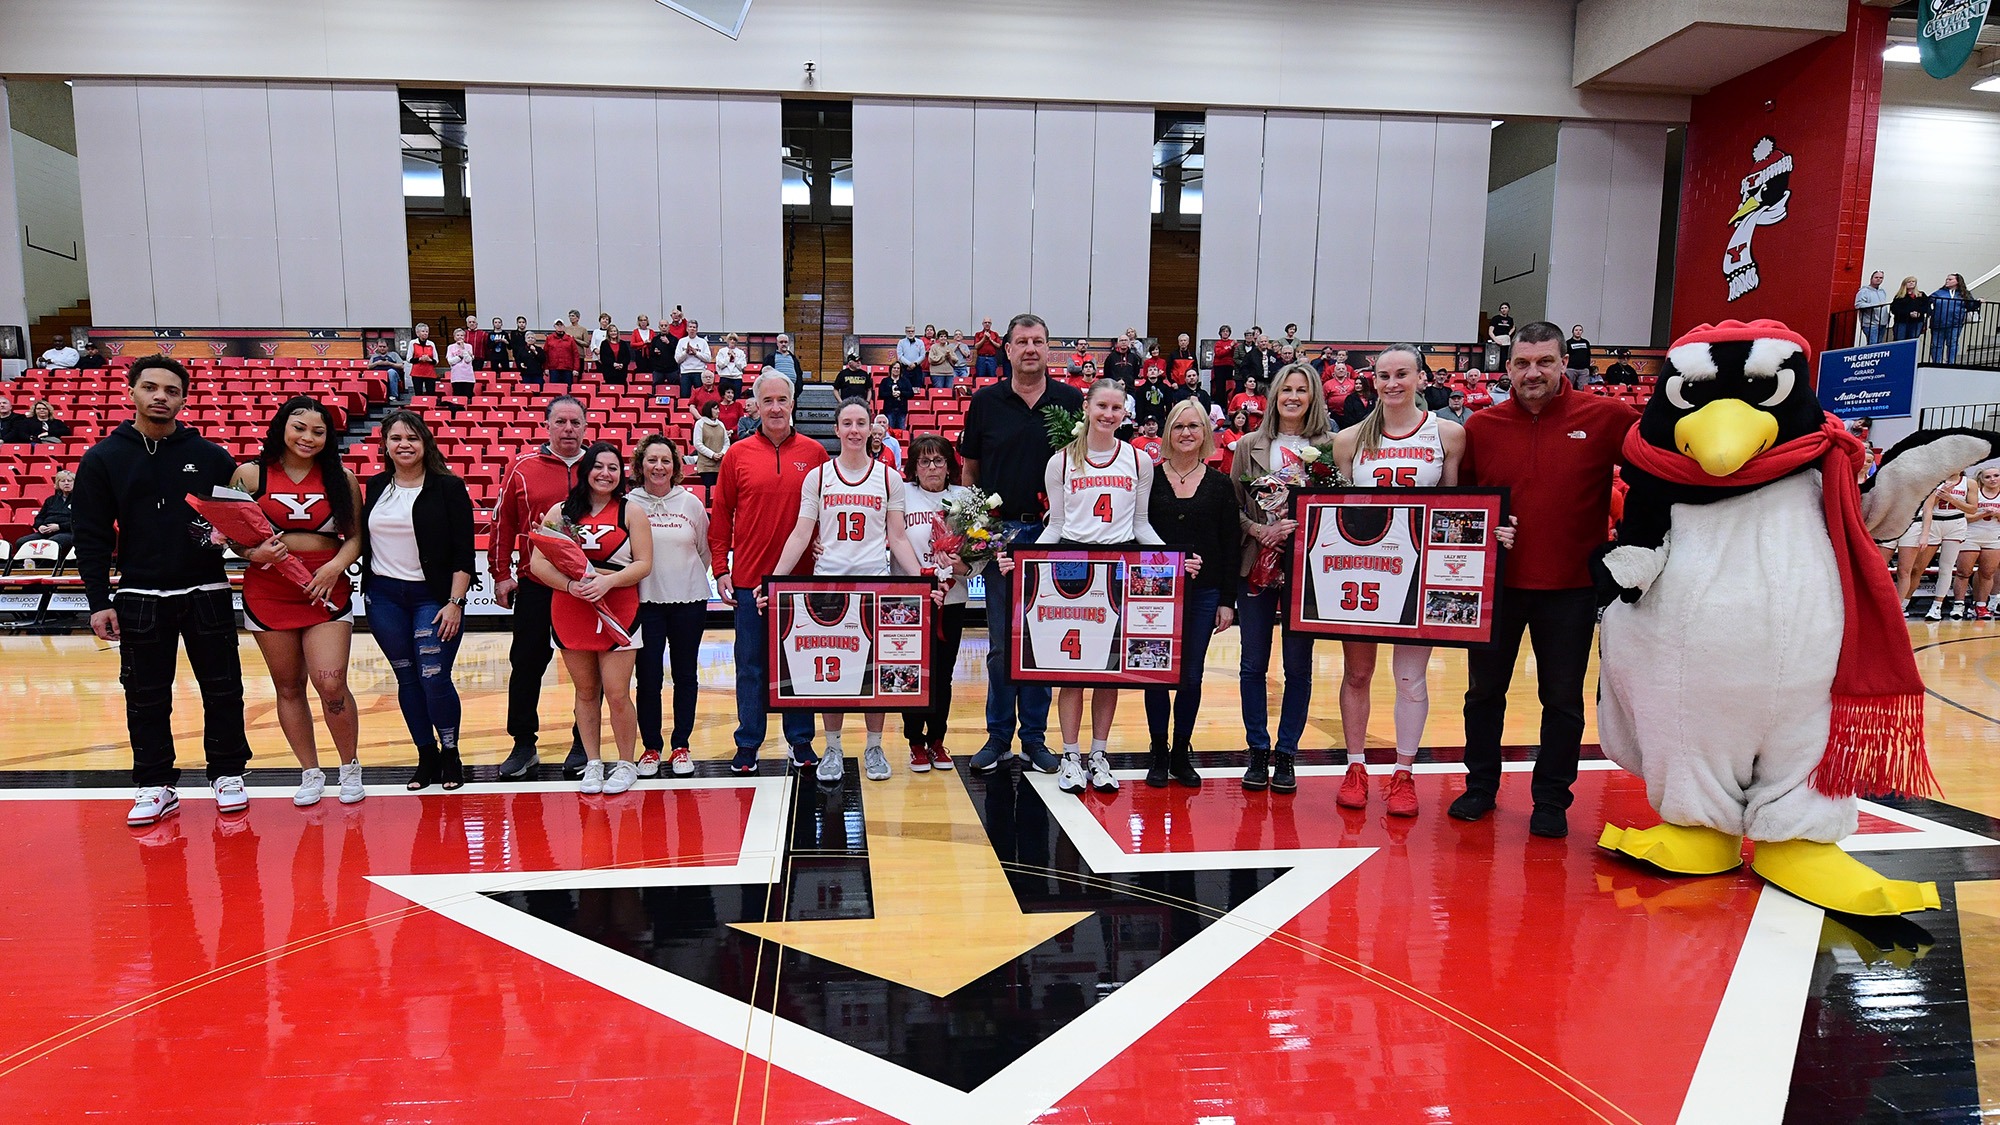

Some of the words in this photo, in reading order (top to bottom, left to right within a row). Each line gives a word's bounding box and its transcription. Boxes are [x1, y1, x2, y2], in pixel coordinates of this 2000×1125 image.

[1925, 2, 1988, 36] CLEVELAND
[1937, 19, 1968, 37] STATE
[1747, 173, 1760, 187] Y
[1727, 242, 1747, 264] Y
[5, 339, 11, 350] 1
[76, 340, 85, 350] 2
[105, 342, 124, 356] Y
[157, 342, 176, 356] Y
[208, 342, 227, 356] Y
[260, 342, 279, 356] Y
[311, 343, 330, 356] Y
[400, 340, 407, 351] 2
[1206, 351, 1213, 361] 5
[1489, 355, 1496, 365] 5
[1844, 355, 1857, 363] THE
[1857, 350, 1890, 361] GRIFFITH
[1632, 361, 1648, 372] Y
[1850, 359, 1880, 369] AGENCY
[1854, 368, 1875, 376] GIRARD
[1834, 390, 1891, 401] Auto-Owners
[1844, 398, 1879, 406] INSURANCE
[793, 462, 807, 472] Y
[1373, 467, 1418, 487] 35
[1071, 475, 1133, 494] PENGUINS
[270, 493, 324, 520] Y
[823, 493, 883, 512] PENGUINS
[1093, 493, 1113, 523] 4
[837, 511, 867, 542] 13
[905, 511, 933, 530] YOUNG
[578, 524, 615, 550] Y
[1322, 555, 1404, 576] PENGUINS
[1340, 581, 1380, 611] 35
[1037, 605, 1107, 624] PENGUINS
[795, 635, 860, 653] PENGUINS
[1060, 629, 1081, 660] 4
[813, 656, 841, 683] 13
